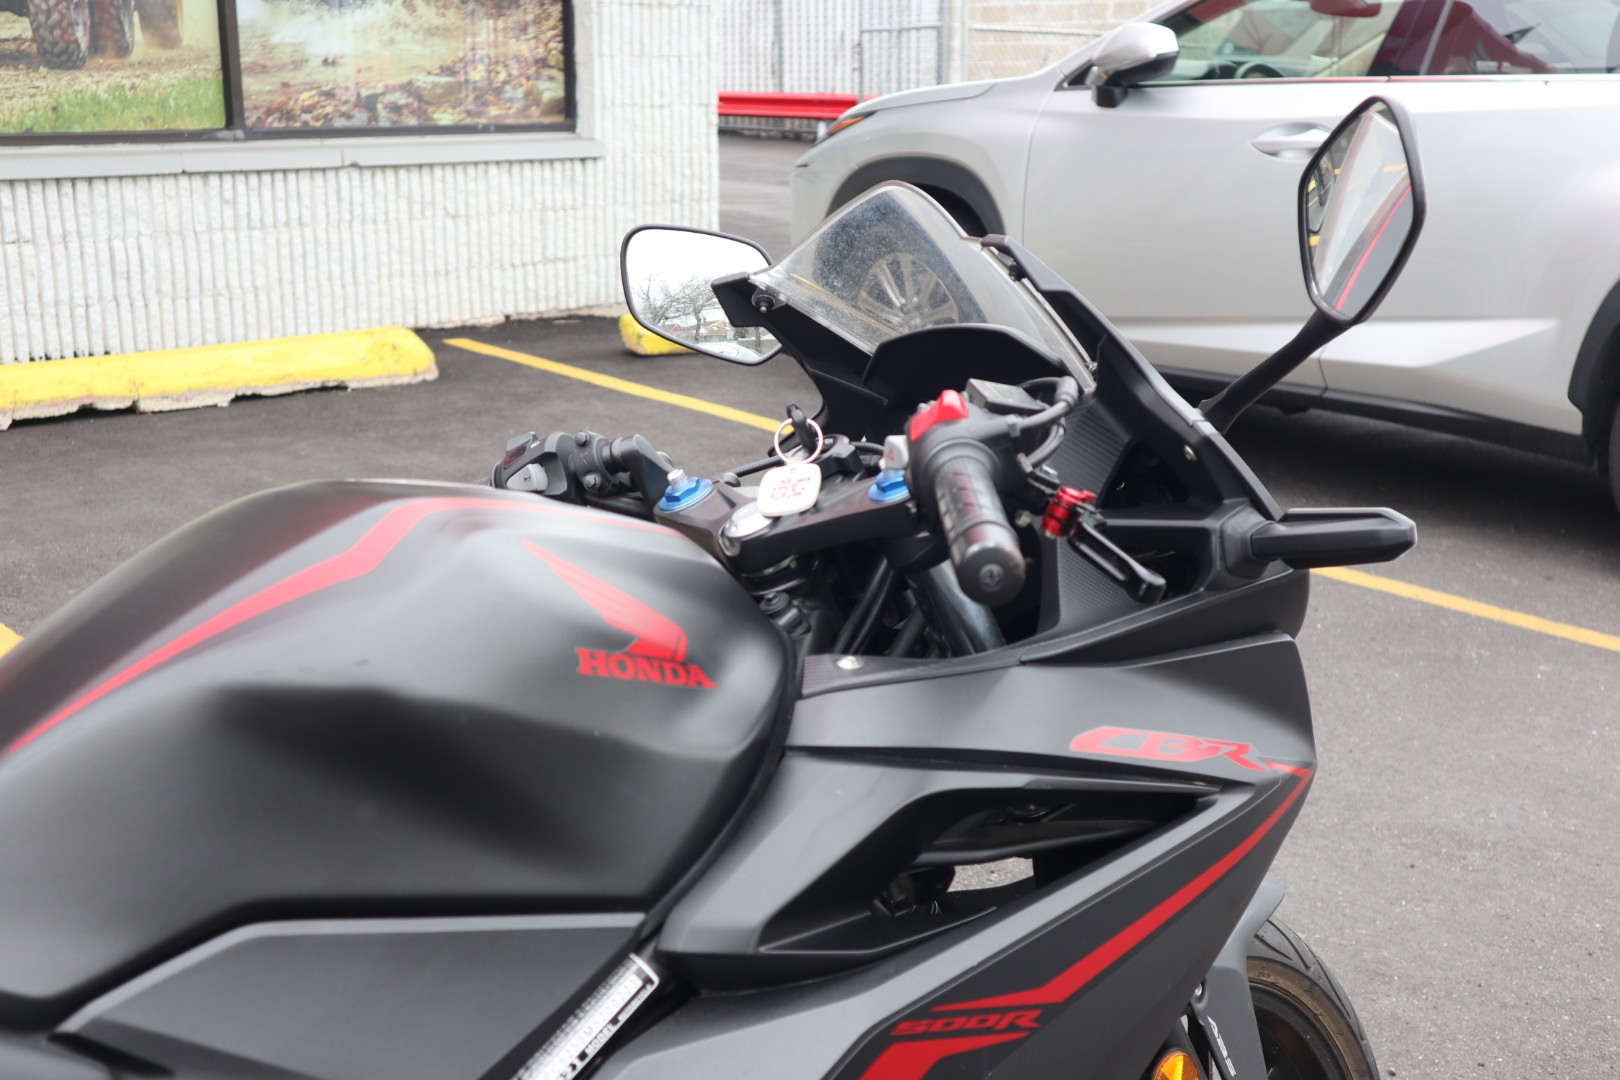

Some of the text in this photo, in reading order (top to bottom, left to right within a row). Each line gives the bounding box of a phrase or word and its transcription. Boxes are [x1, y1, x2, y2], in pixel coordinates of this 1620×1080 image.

[574, 647, 718, 689] HONDA
[1069, 725, 1271, 773] CBR
[889, 1009, 1043, 1036] 500R
[1207, 1015, 1236, 1077] ABS
